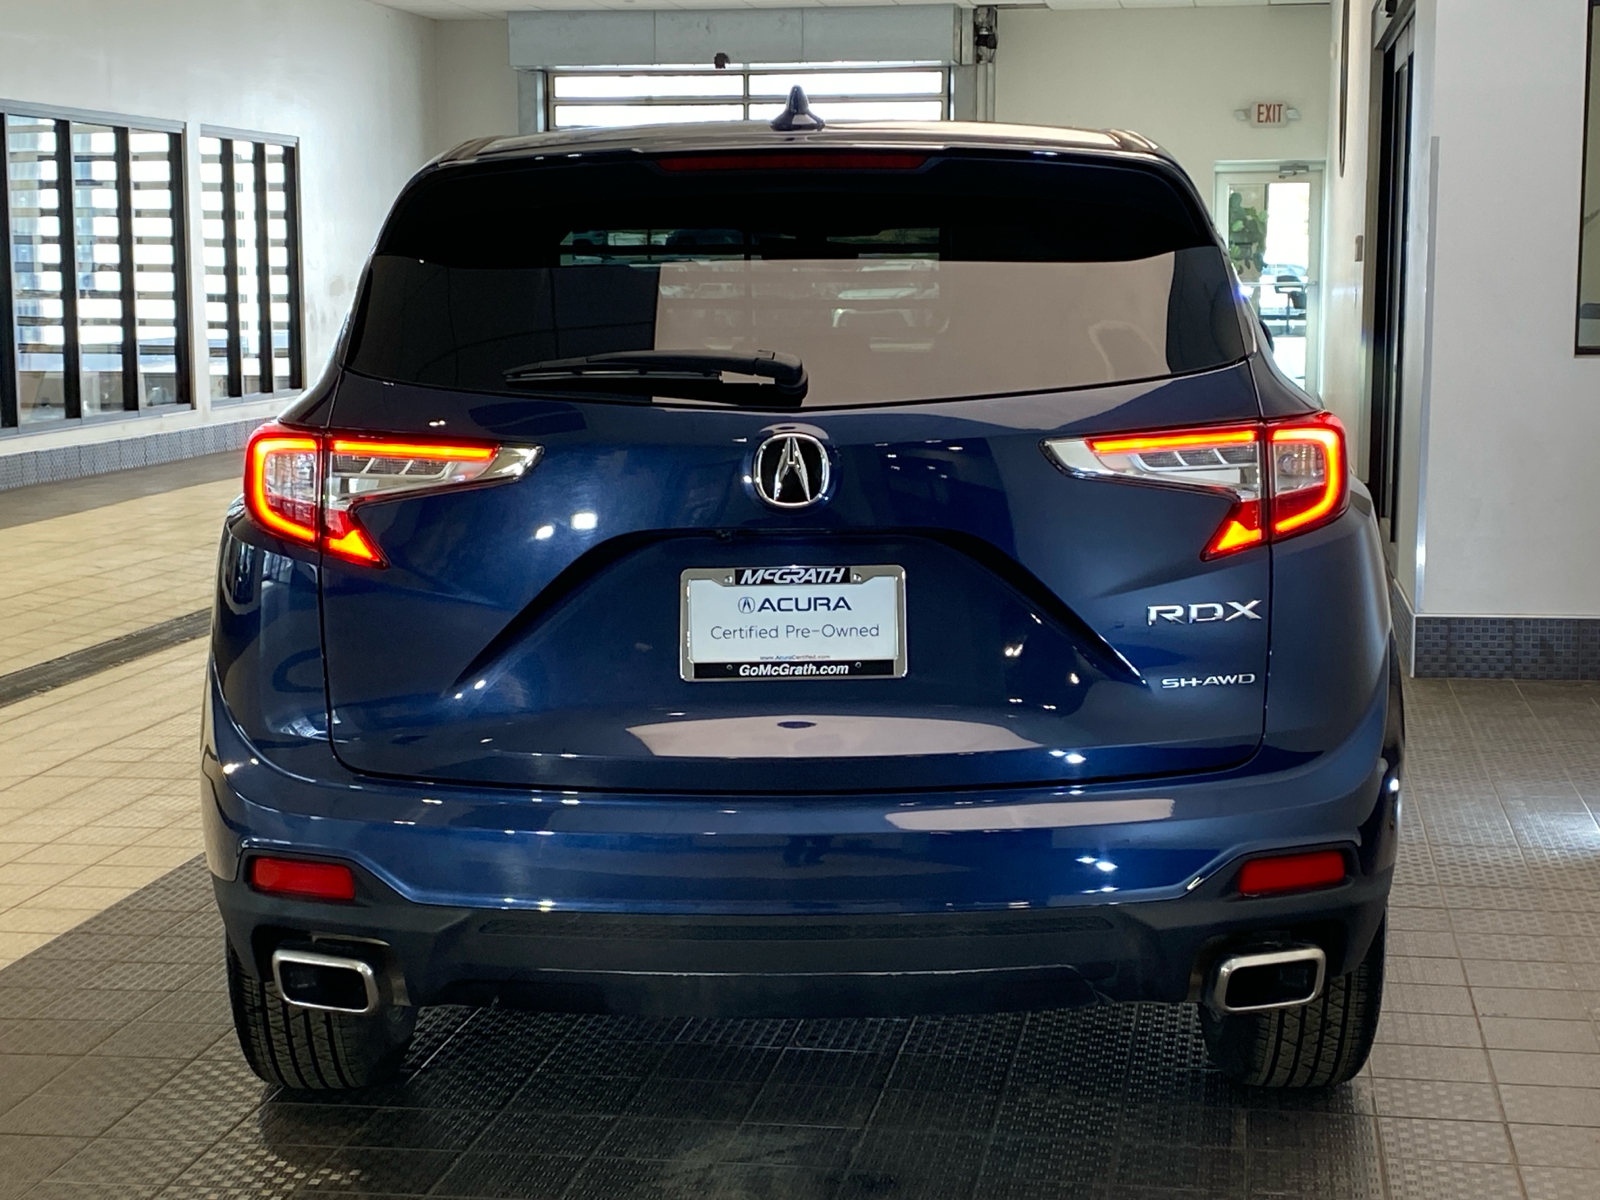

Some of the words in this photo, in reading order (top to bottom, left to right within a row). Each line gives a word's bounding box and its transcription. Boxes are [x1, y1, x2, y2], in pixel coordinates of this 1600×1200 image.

[1257, 104, 1283, 123] EXIT
[757, 596, 852, 612] ACURA
[1147, 599, 1262, 626] RDX
[710, 625, 779, 640] Certified
[786, 623, 880, 638] Pre-Owned
[739, 663, 849, 676] GoMcGrath.com
[1161, 674, 1255, 689] SH-AWD
